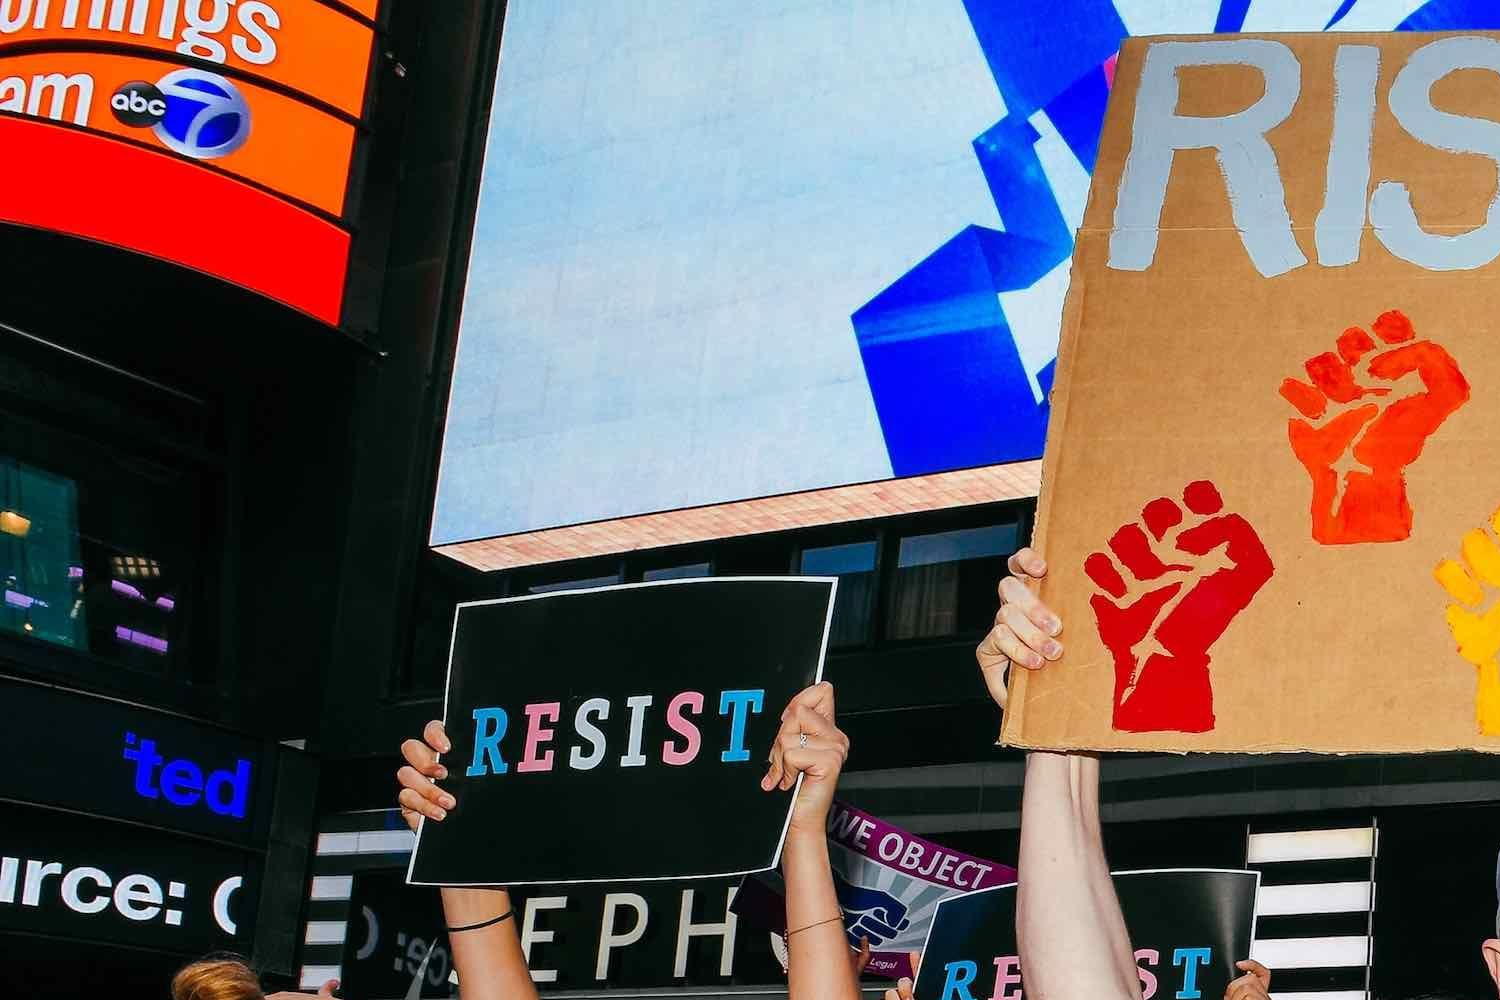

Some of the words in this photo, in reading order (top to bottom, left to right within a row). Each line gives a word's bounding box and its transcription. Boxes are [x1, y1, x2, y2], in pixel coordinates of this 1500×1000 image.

[111, 91, 167, 116] abc
[466, 689, 765, 776] RESIST
[124, 731, 252, 819] ted
[878, 832, 992, 890] OBJECT
[869, 957, 898, 970] Legal
